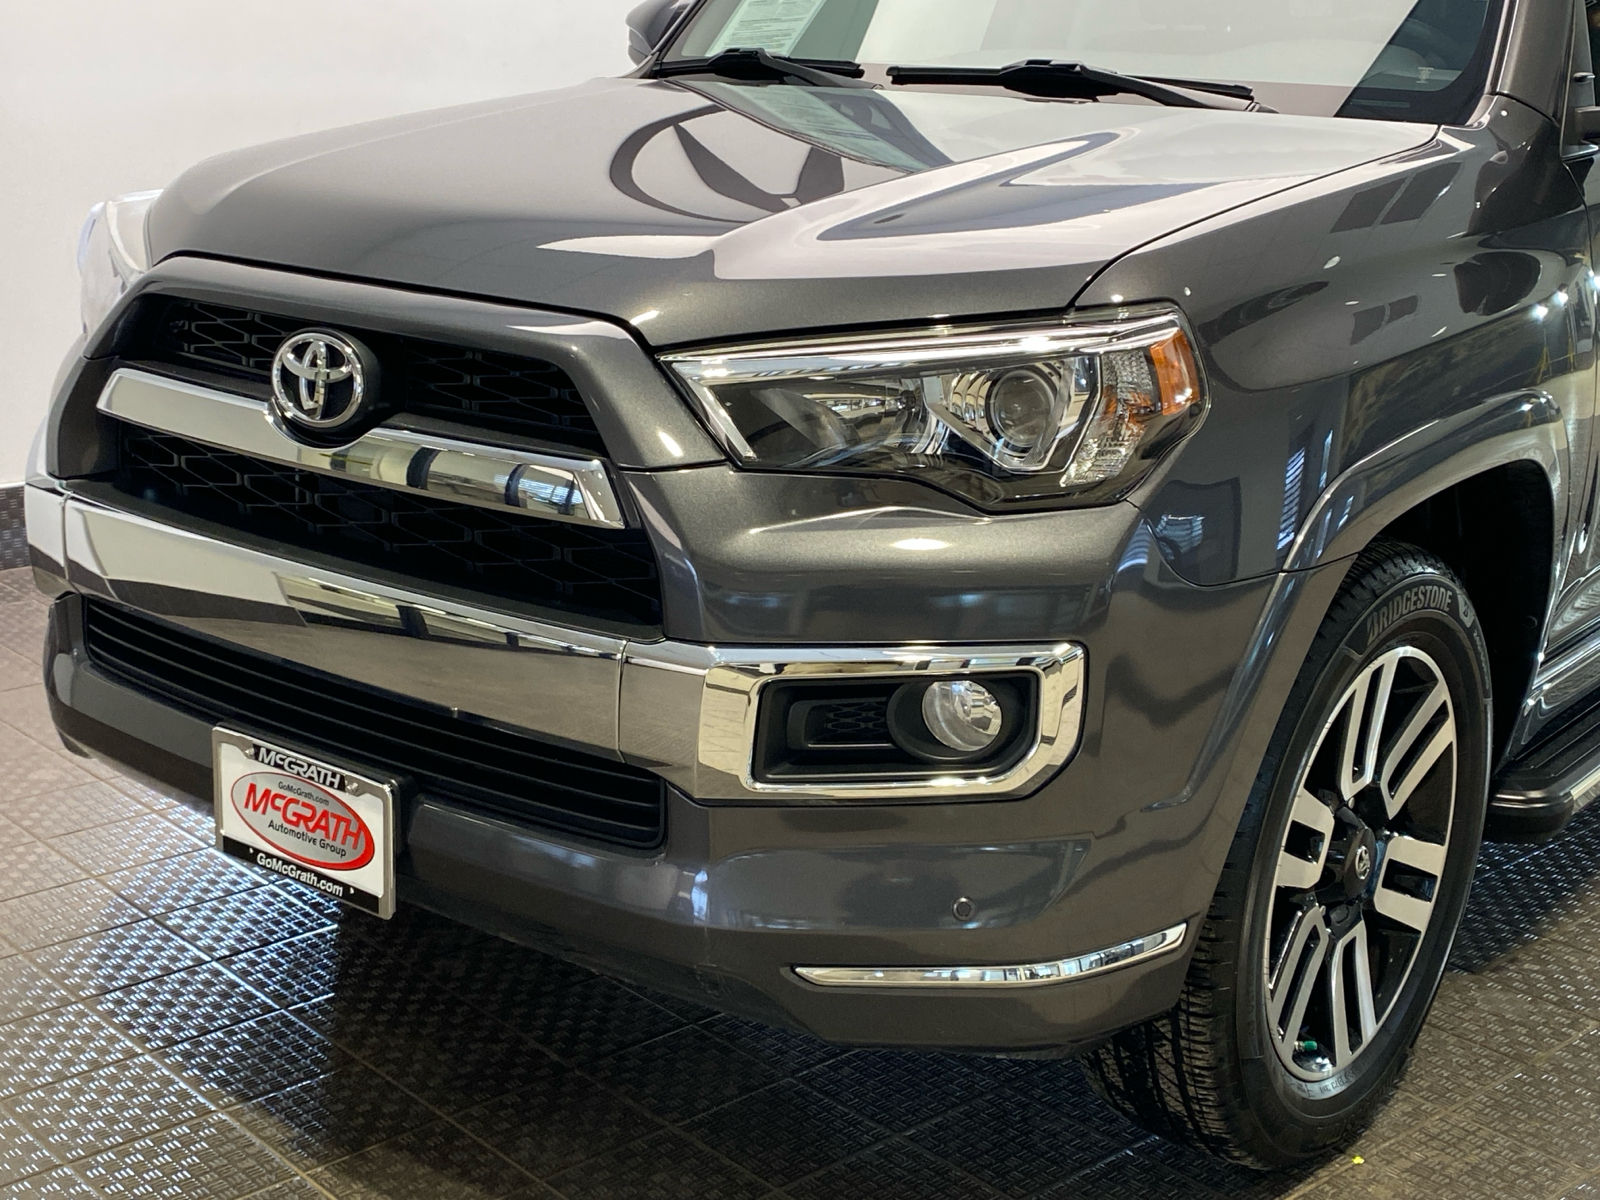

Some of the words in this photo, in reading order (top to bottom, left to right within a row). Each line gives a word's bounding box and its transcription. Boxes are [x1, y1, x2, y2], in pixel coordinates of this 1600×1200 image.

[1366, 585, 1453, 647] BRIDGESTONE
[278, 781, 330, 807] GoMcGrath.com
[268, 820, 318, 846] Automotive
[319, 839, 347, 859] Group
[256, 852, 344, 897] GoMcGrath.com
